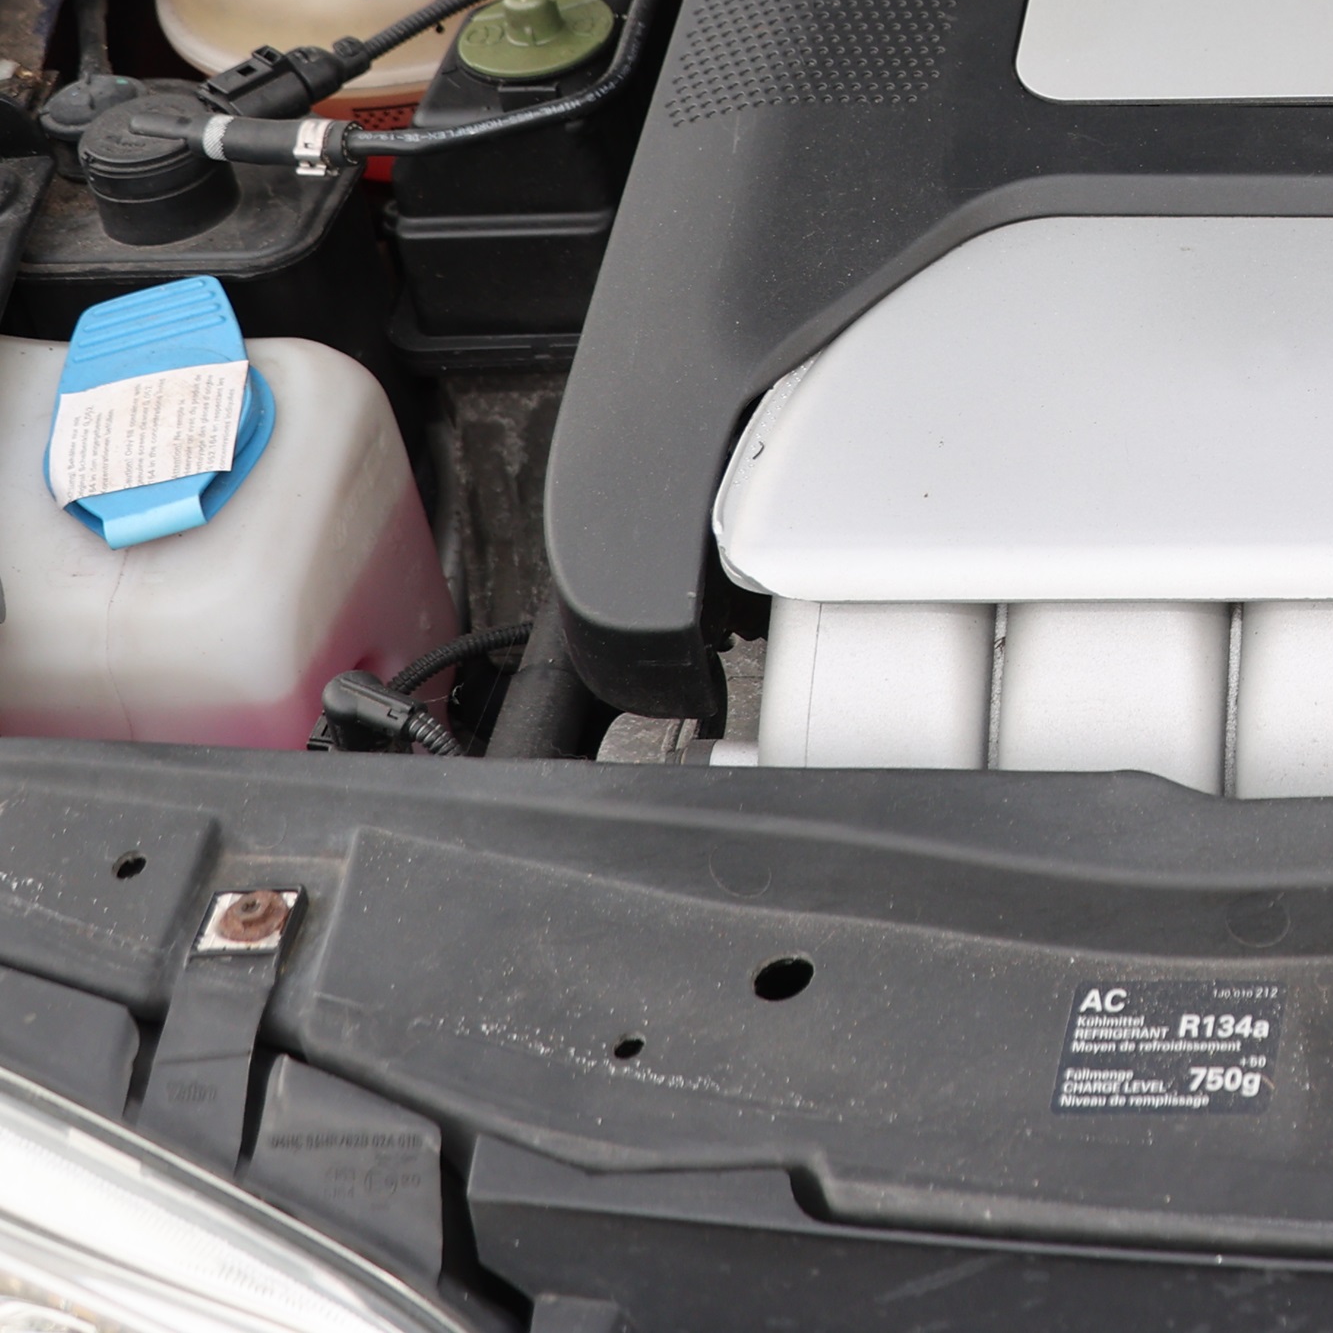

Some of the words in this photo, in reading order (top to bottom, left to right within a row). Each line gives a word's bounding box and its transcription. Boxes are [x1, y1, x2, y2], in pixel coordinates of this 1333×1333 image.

[1255, 987, 1278, 998] 212
[1080, 988, 1127, 1013] AC
[1179, 1013, 1270, 1038] R134a
[1074, 1027, 1169, 1040] REFRIGERANT
[1072, 1040, 1117, 1055] Moyen
[1120, 1040, 1136, 1052] de
[1139, 1040, 1241, 1052] refroidissement
[1063, 1080, 1121, 1094] CHARGE
[1124, 1080, 1167, 1093] LEVEL
[1189, 1067, 1262, 1098] 750g
[1060, 1094, 1107, 1107] Niveau
[1110, 1094, 1126, 1106] de
[1129, 1094, 1210, 1108] remplissage
